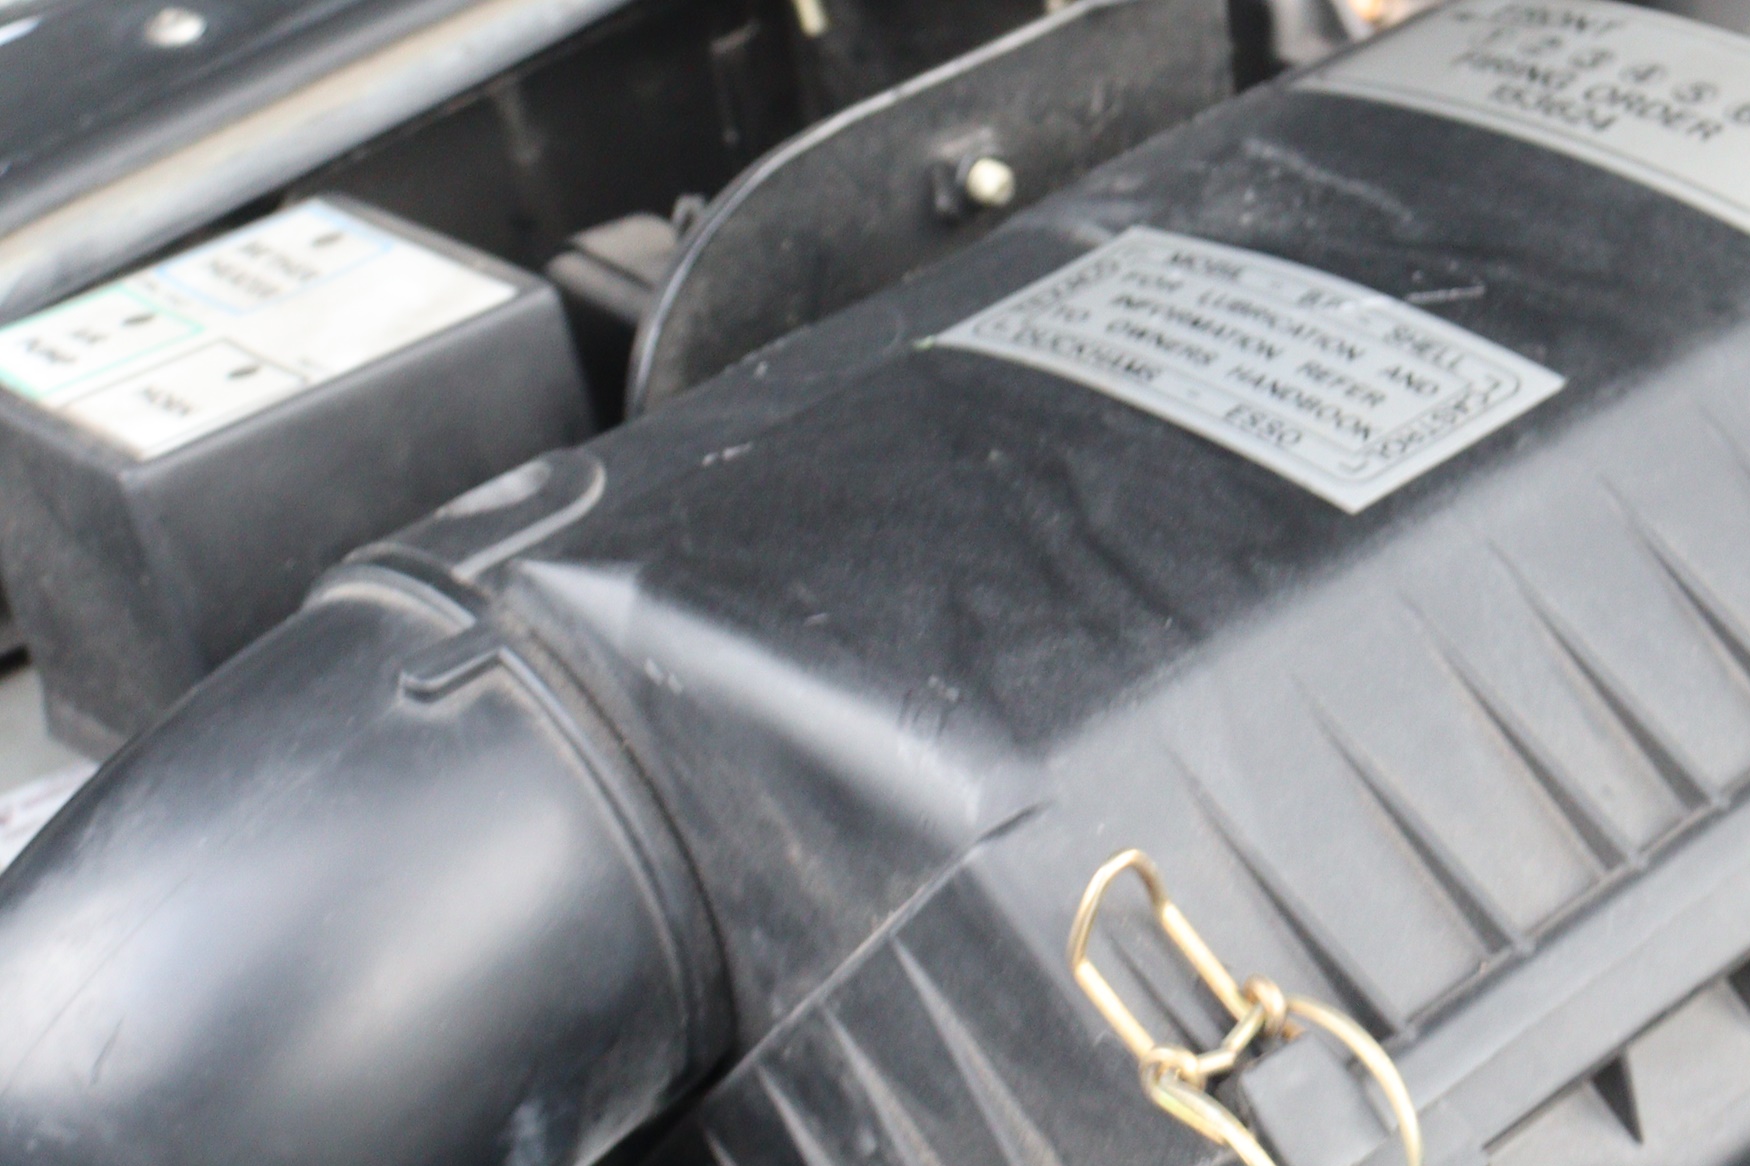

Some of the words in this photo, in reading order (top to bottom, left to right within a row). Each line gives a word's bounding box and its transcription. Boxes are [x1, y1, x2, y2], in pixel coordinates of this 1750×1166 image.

[1375, 322, 1471, 369] SHELL
[1222, 362, 1384, 442] HANDBOOK
[1290, 359, 1394, 408] REFER
[1375, 362, 1451, 398] AND
[1214, 403, 1313, 450] ESSO
